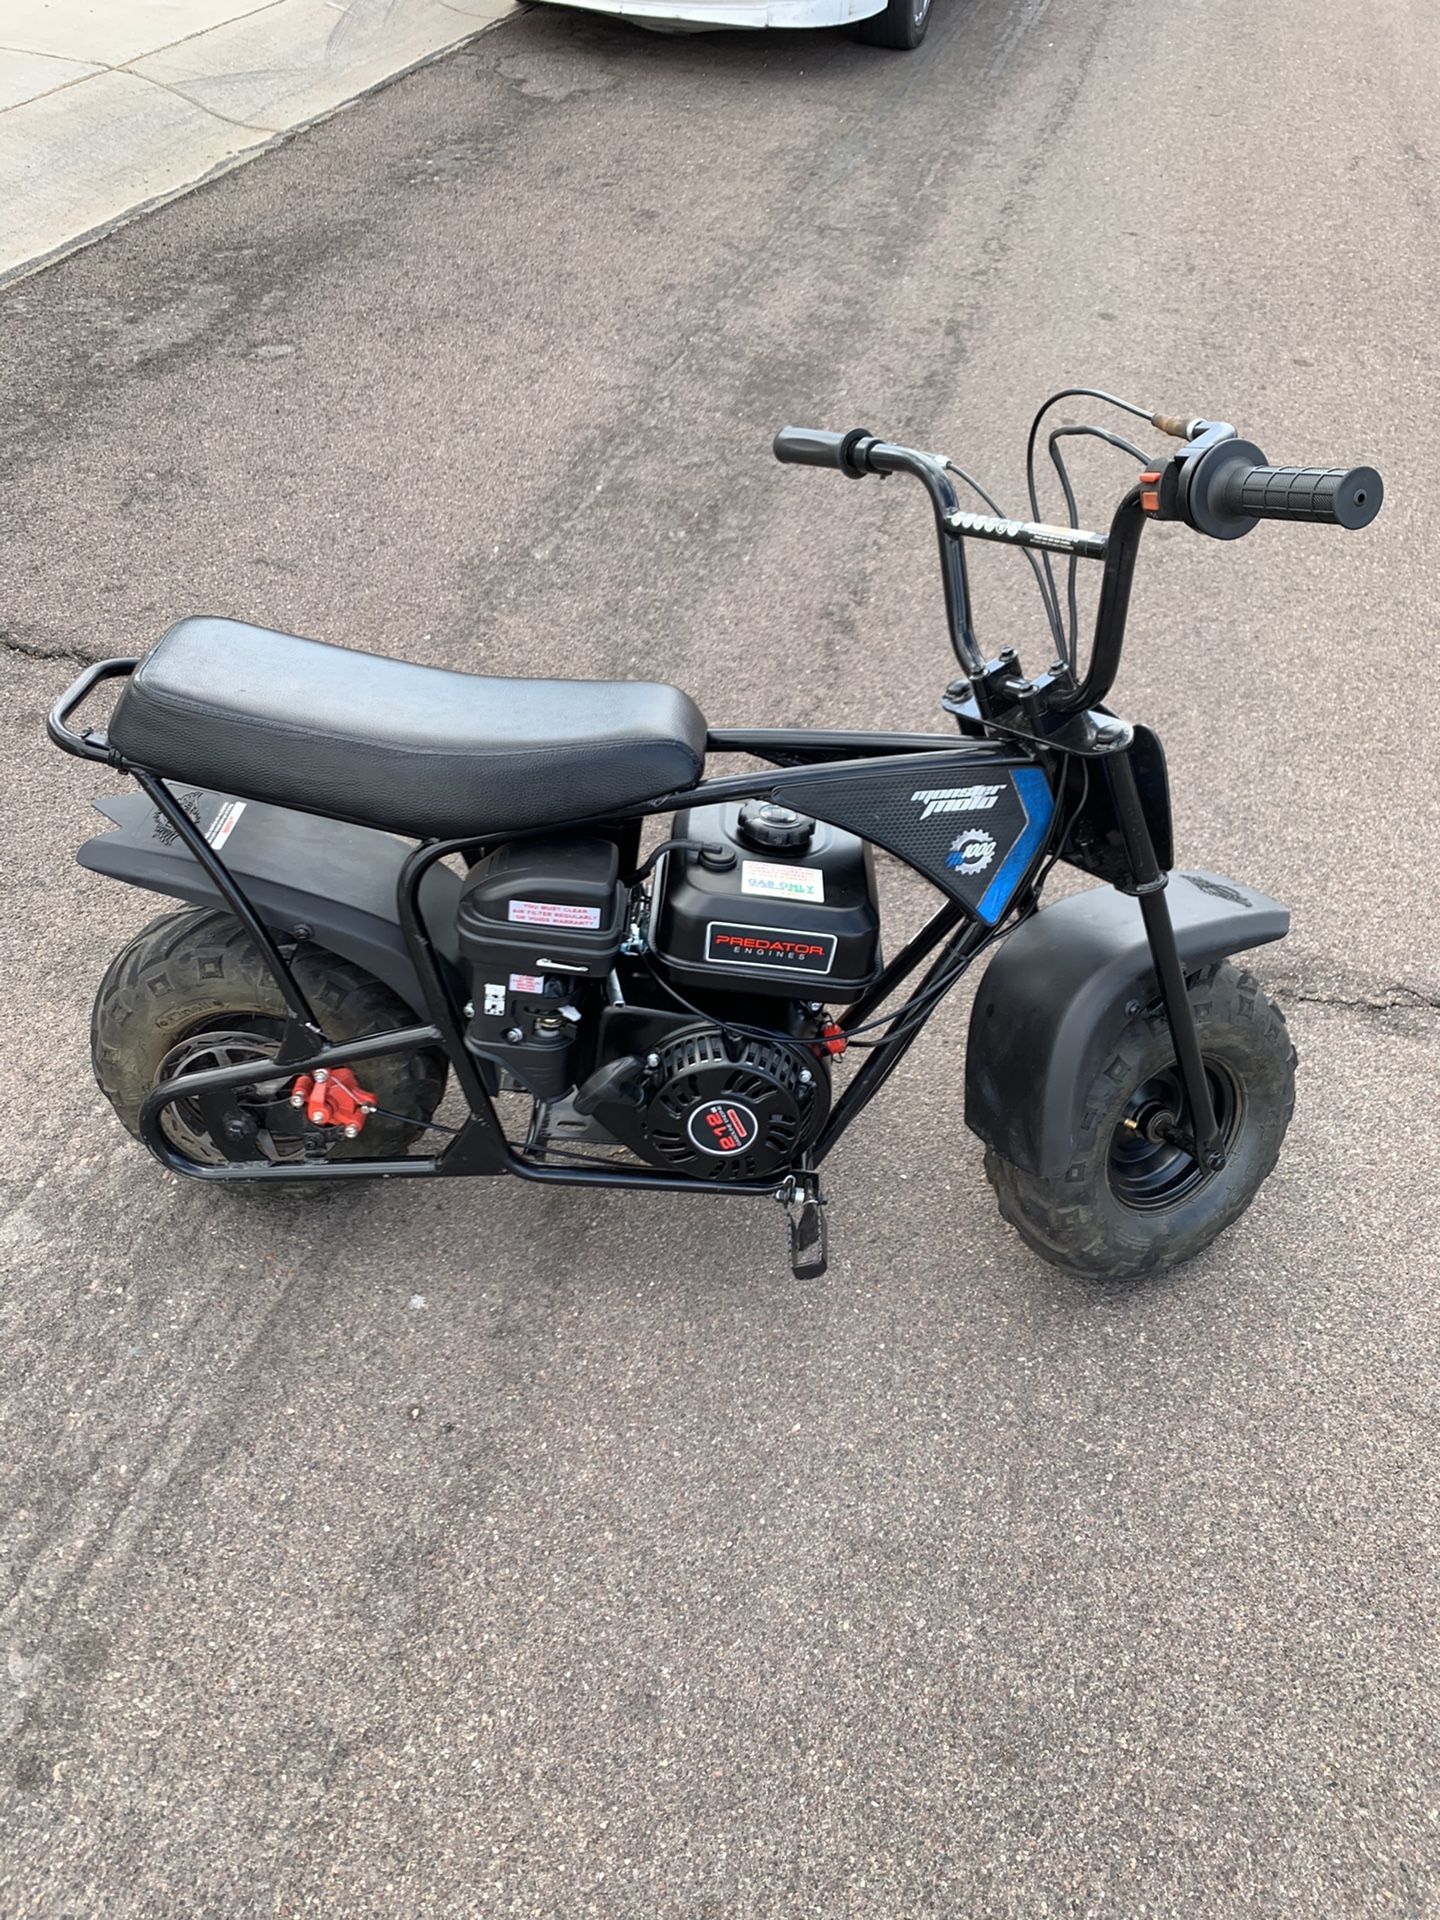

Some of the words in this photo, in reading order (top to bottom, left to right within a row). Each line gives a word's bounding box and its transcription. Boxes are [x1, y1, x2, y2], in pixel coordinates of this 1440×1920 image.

[962, 841, 997, 858] 1000
[715, 935, 824, 956] PREDATOR
[733, 946, 806, 960] ENGINES
[706, 1112, 737, 1150] 212
